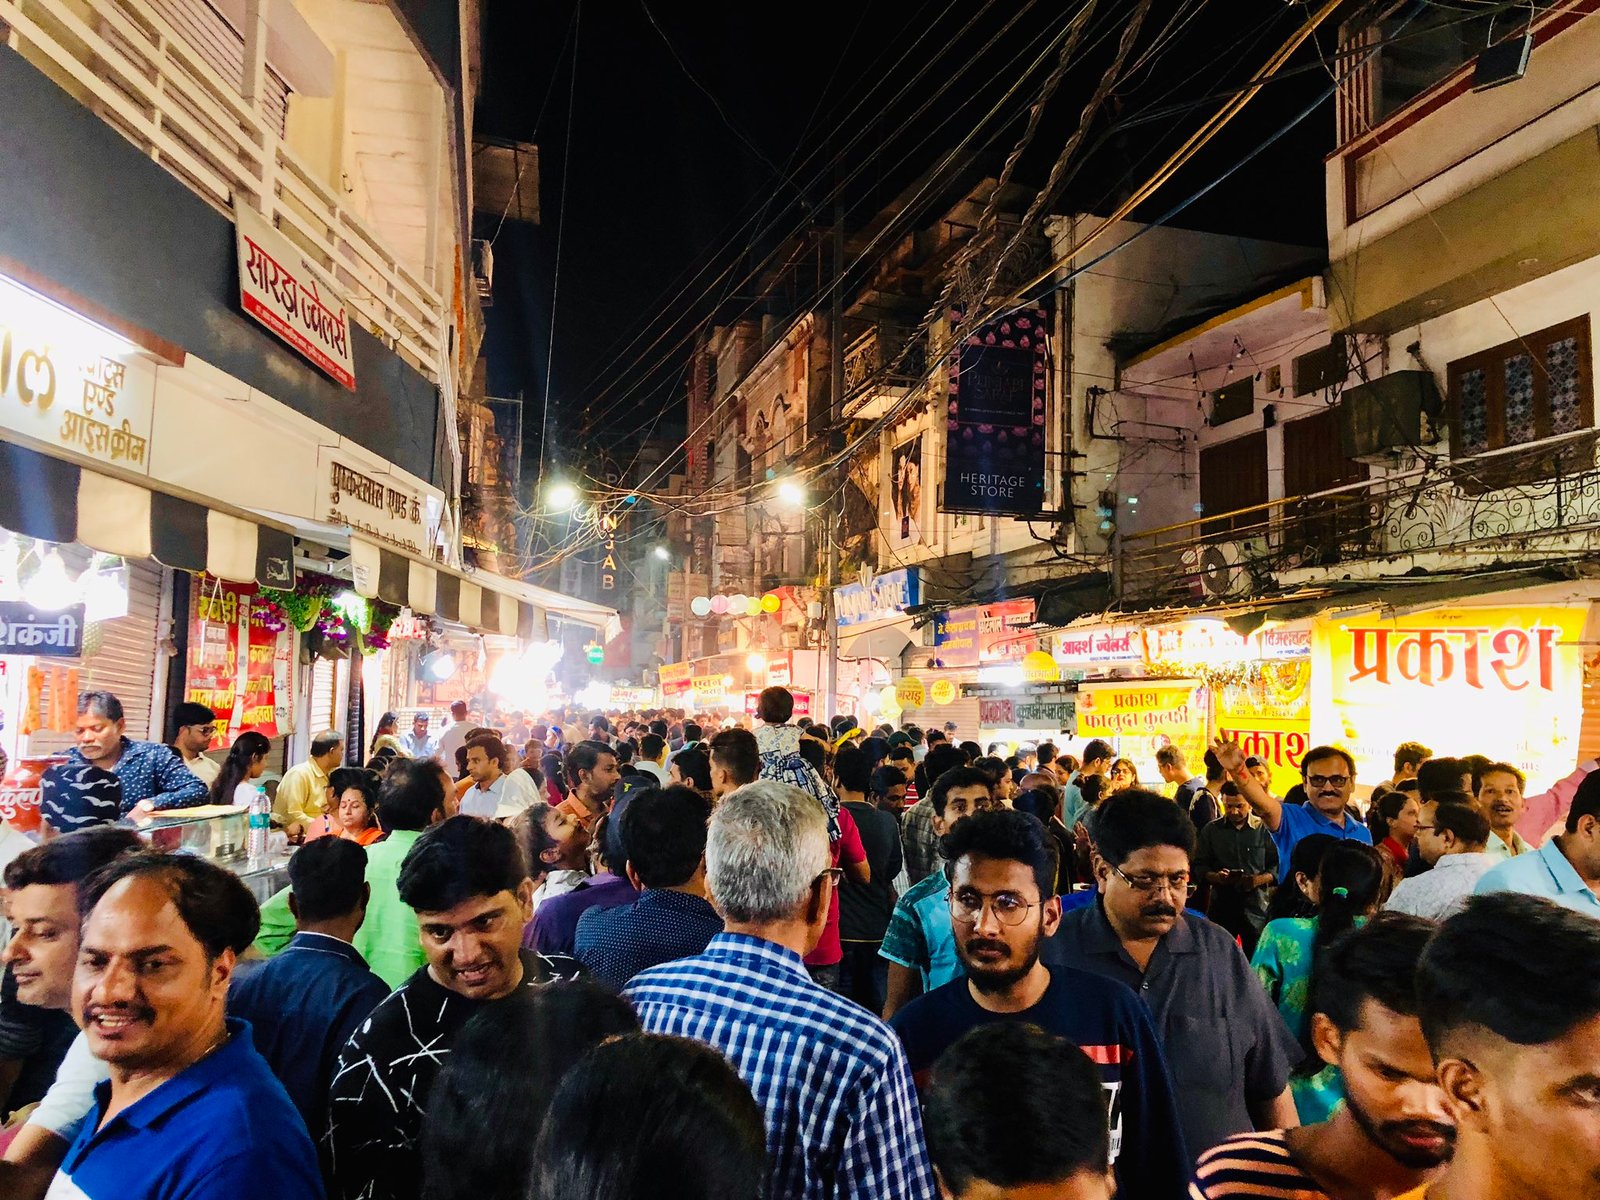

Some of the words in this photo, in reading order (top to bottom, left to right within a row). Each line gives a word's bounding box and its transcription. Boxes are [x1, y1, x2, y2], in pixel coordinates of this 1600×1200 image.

[299, 279, 348, 360] ज्वेलर्स
[83, 379, 116, 416] एण्ड
[960, 472, 1025, 488] HERITAGE
[970, 484, 1014, 498] STORE
[1062, 634, 1094, 655] आदर्श
[1096, 631, 1130, 653] ज्वेलर्स
[1347, 628, 1558, 692] प्रकाश
[1113, 692, 1159, 708] प्रकाश
[1143, 705, 1188, 732] कुल्फी
